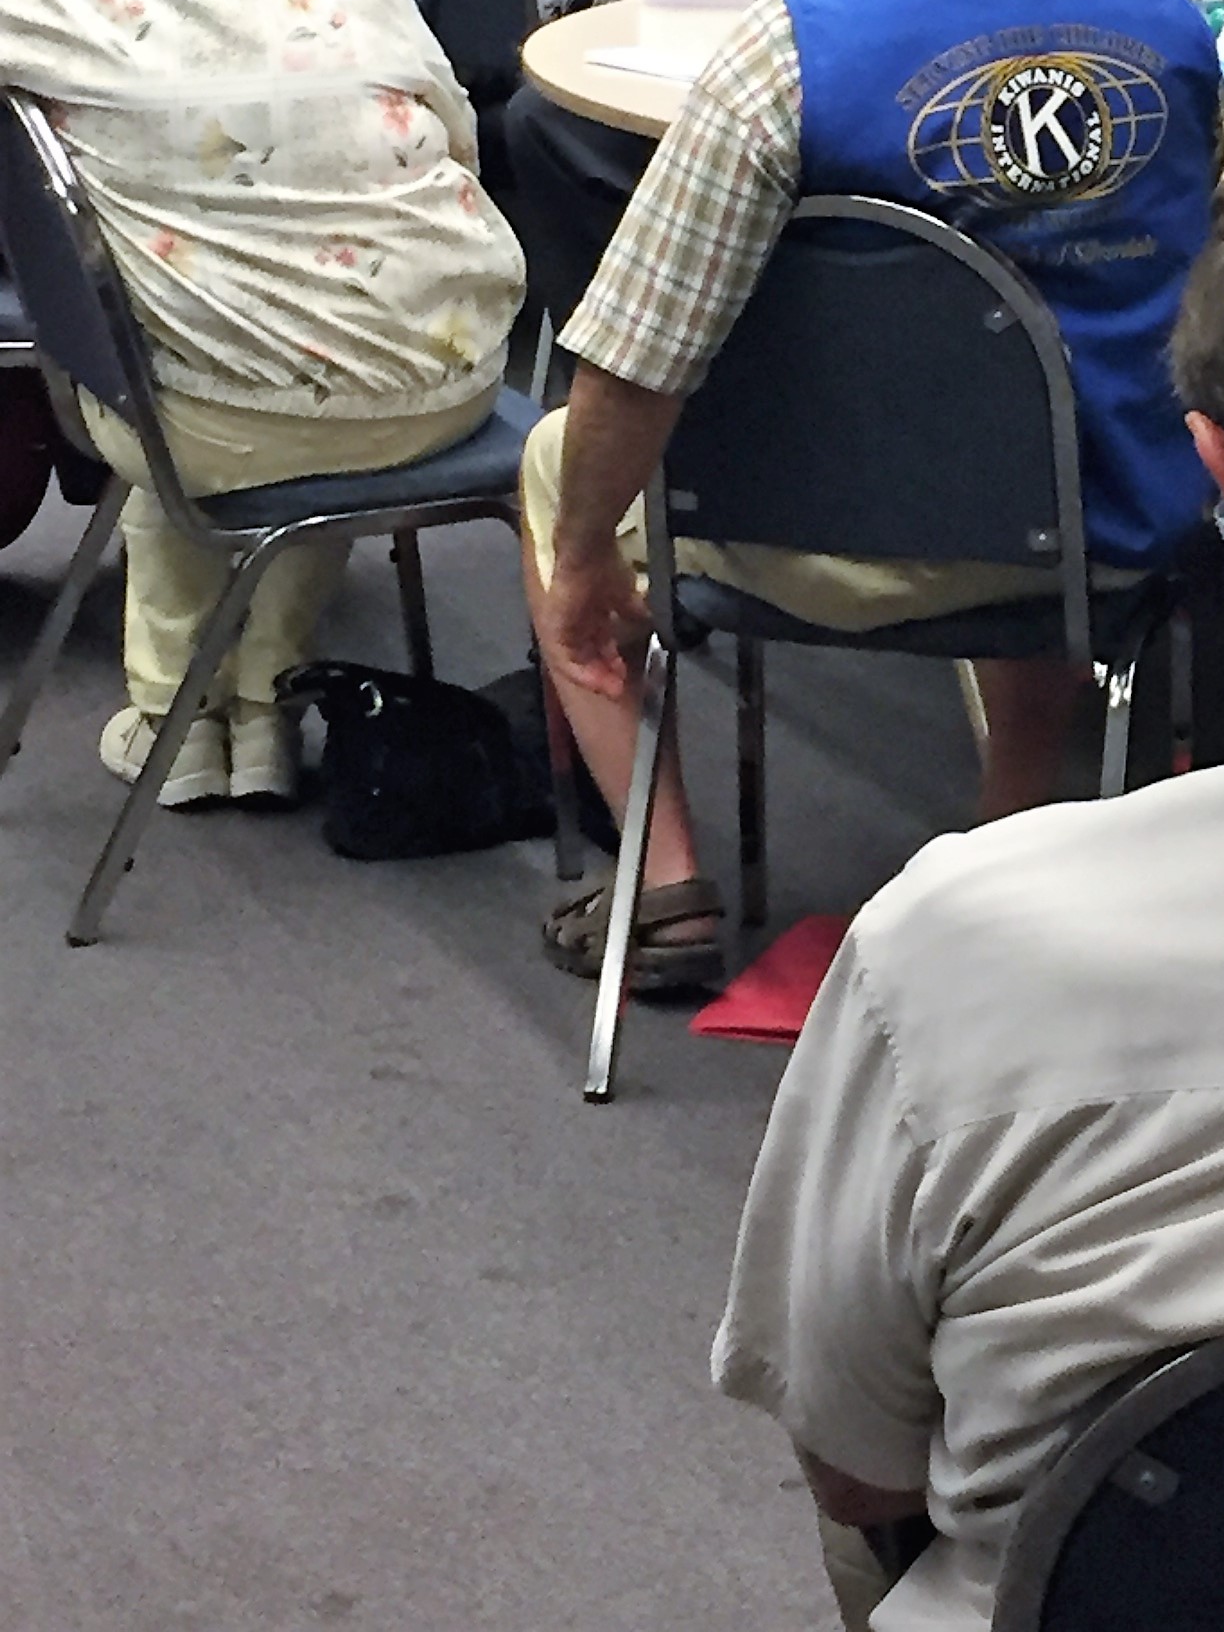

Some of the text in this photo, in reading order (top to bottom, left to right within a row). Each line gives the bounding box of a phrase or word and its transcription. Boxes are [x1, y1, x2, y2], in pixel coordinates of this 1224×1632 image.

[998, 67, 1086, 106] KIWANIS
[990, 111, 1102, 193] INTERNATIONAL
[1016, 88, 1082, 178] K
